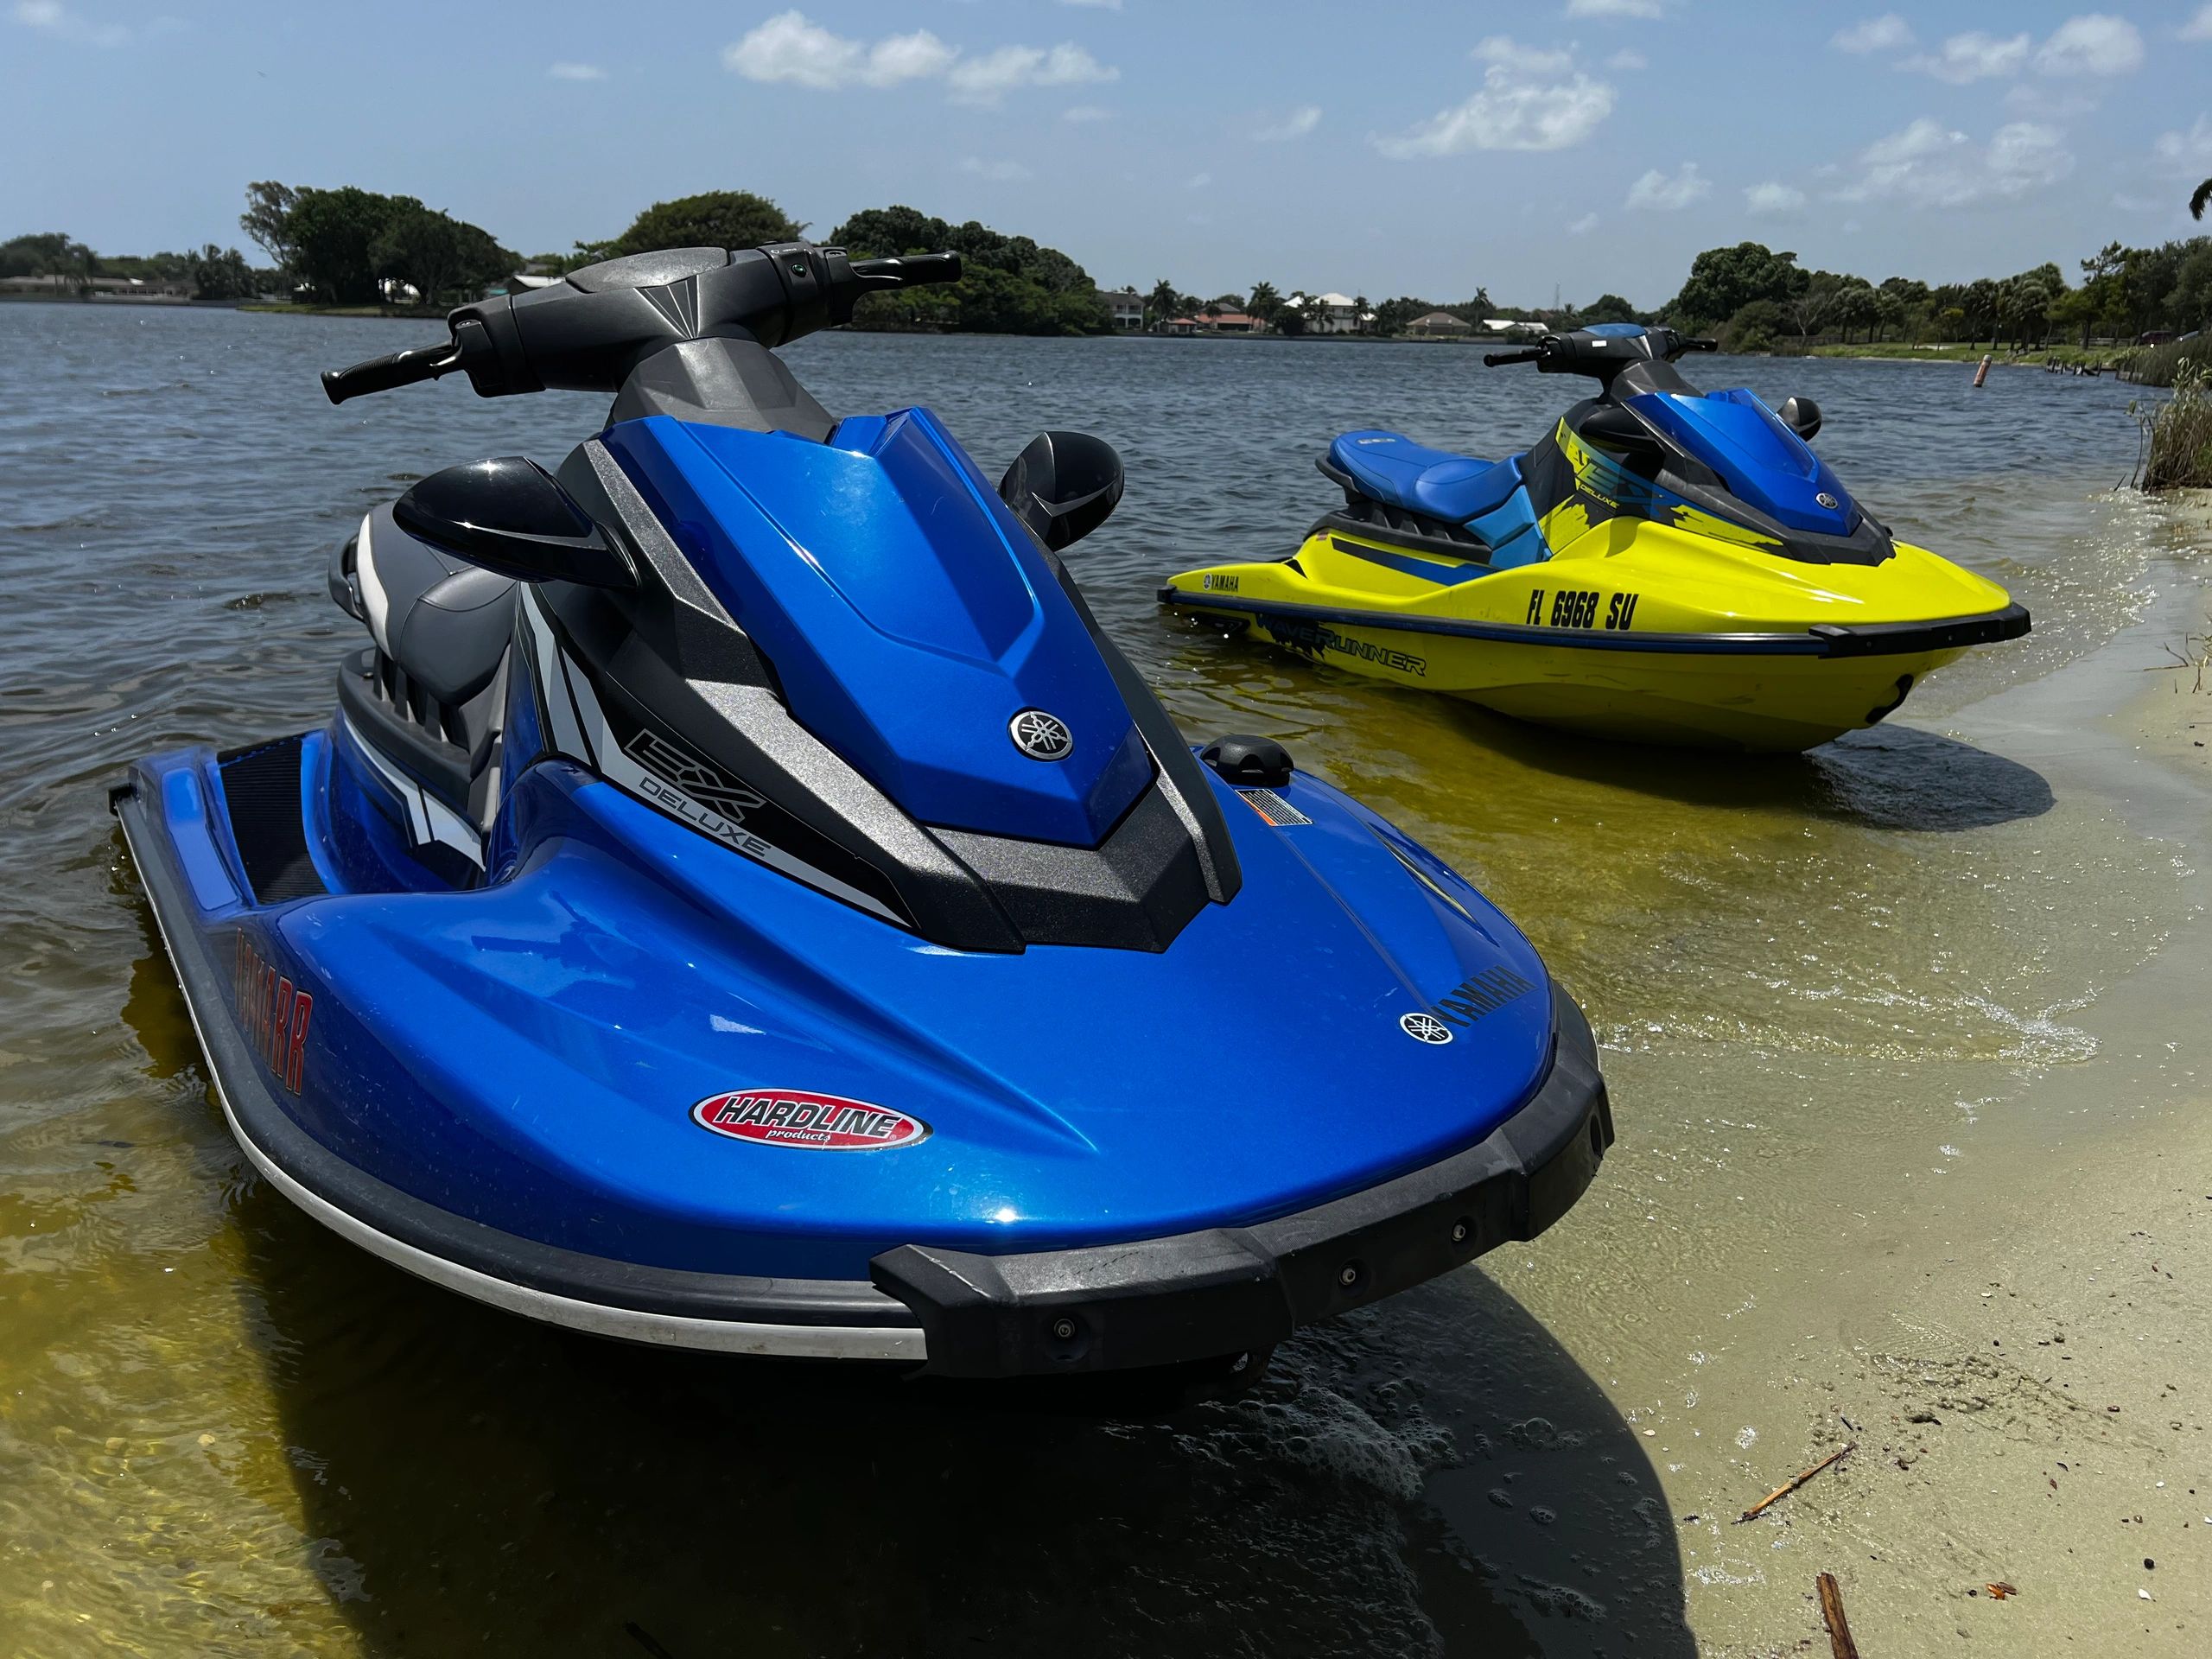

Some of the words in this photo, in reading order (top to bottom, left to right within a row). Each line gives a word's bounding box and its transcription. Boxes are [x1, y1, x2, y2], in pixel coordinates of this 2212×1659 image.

[1580, 484, 1620, 509] DELUXE
[1211, 574, 1239, 592] YAMAHA
[1526, 589, 1545, 625] FL
[1550, 590, 1600, 628] 6968
[1605, 593, 1639, 631] SU
[1256, 613, 1427, 677] WAVERUNNER
[624, 728, 766, 823] EX
[639, 776, 772, 858] DELUXE
[1430, 964, 1539, 1028] YAMAHA
[713, 1096, 903, 1139] HARDLINE
[765, 1128, 831, 1141] products
